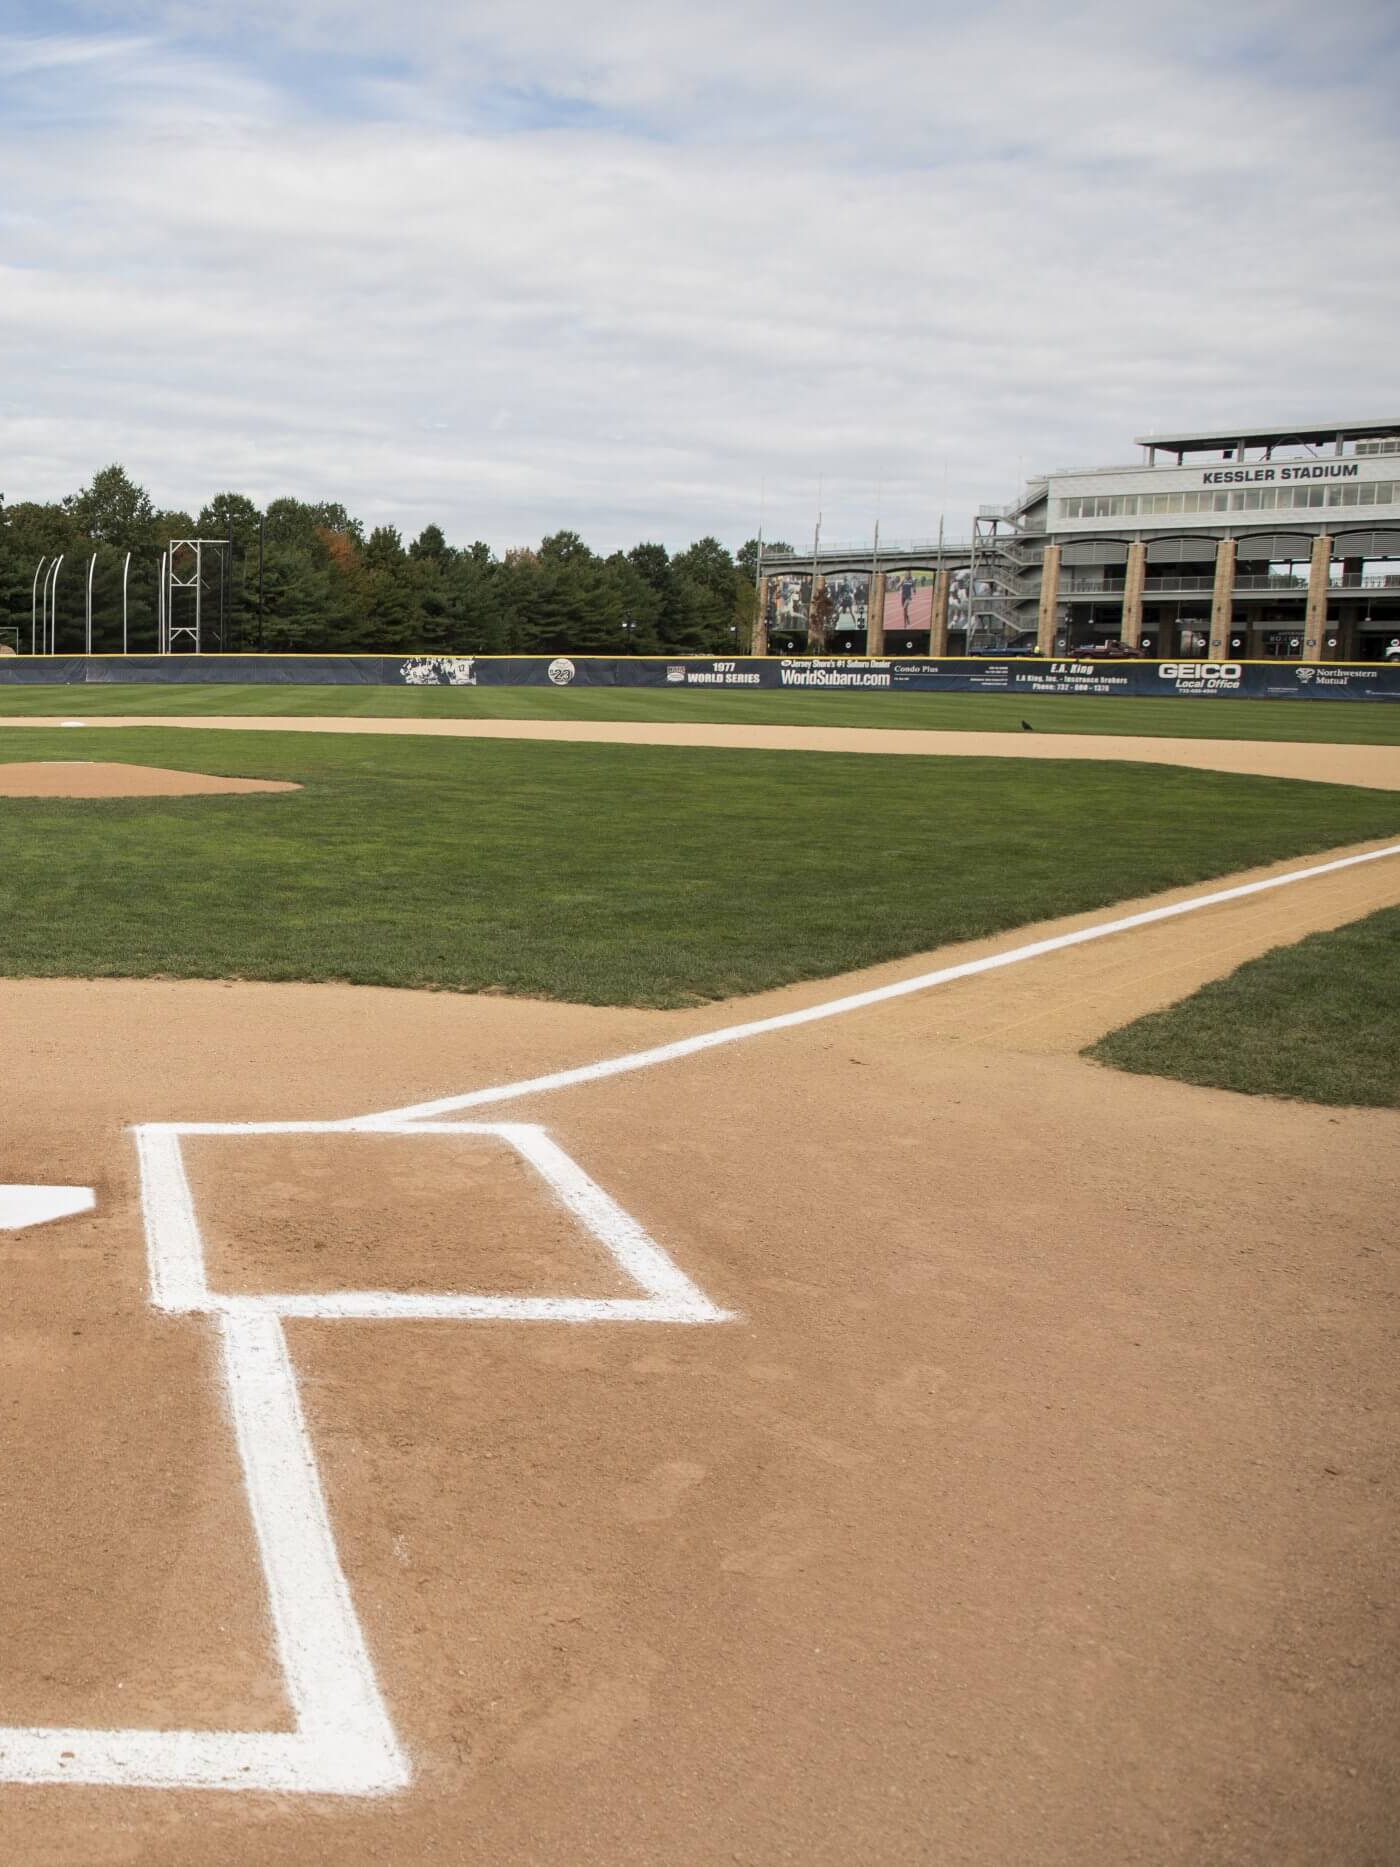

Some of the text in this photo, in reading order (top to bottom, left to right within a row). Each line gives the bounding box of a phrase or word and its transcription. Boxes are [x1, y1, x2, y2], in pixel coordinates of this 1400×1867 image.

[1203, 464, 1358, 484] KESSLER STADIUM
[713, 662, 736, 671] 1977
[791, 660, 811, 669] Jersey
[847, 660, 869, 668] Subaru
[922, 665, 938, 673] Plus
[1050, 663, 1094, 674] E.A. King
[1158, 664, 1241, 679] GEICO
[1316, 668, 1377, 678] Northwestern
[687, 673, 760, 683] WORLD SERIES
[781, 670, 890, 685] WorldSubaru.com
[1316, 677, 1348, 685] Mutual
[1176, 679, 1239, 688] Local Office
